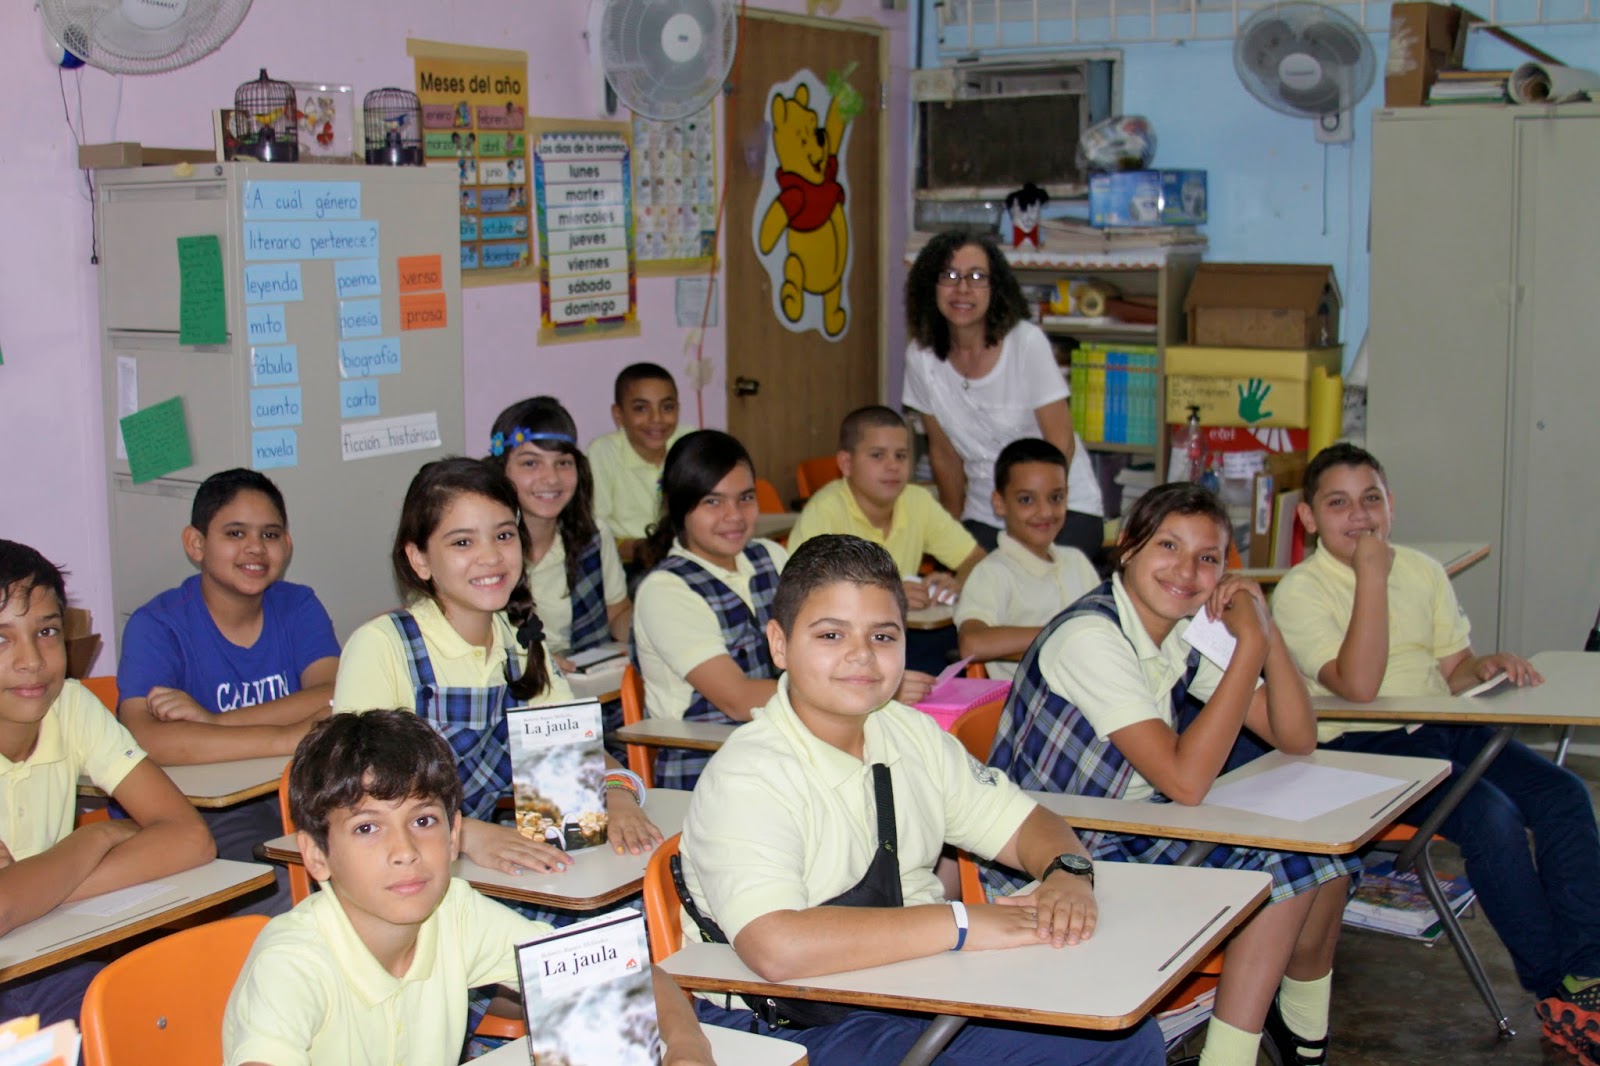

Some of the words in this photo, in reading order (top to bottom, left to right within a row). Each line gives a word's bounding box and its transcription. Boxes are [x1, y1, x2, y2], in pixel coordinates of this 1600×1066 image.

[420, 72, 465, 93] Meses
[469, 75, 491, 94] del
[495, 76, 521, 95] año
[426, 111, 451, 121] enero
[574, 143, 583, 153] de
[569, 165, 600, 178] lunes
[275, 189, 303, 210] cuál
[315, 191, 358, 219] género
[566, 188, 605, 201] martes
[249, 230, 301, 250] literario
[310, 227, 377, 256] pertenece?
[569, 233, 606, 250] jueves
[568, 257, 609, 271] viernes
[245, 271, 298, 299] leyenda
[337, 274, 377, 296] poema
[402, 272, 438, 285] verso
[565, 300, 615, 316] domingo
[250, 313, 282, 334] mito
[406, 309, 442, 329] prosa
[341, 345, 398, 377] biografía
[256, 396, 299, 417] cuento
[346, 391, 377, 409] carta
[256, 438, 294, 457] novela
[344, 432, 381, 454] ficción
[387, 425, 437, 447] histórica
[524, 723, 542, 735] La
[545, 718, 580, 737] jaula
[544, 960, 567, 977] La
[572, 945, 618, 976] jaula
